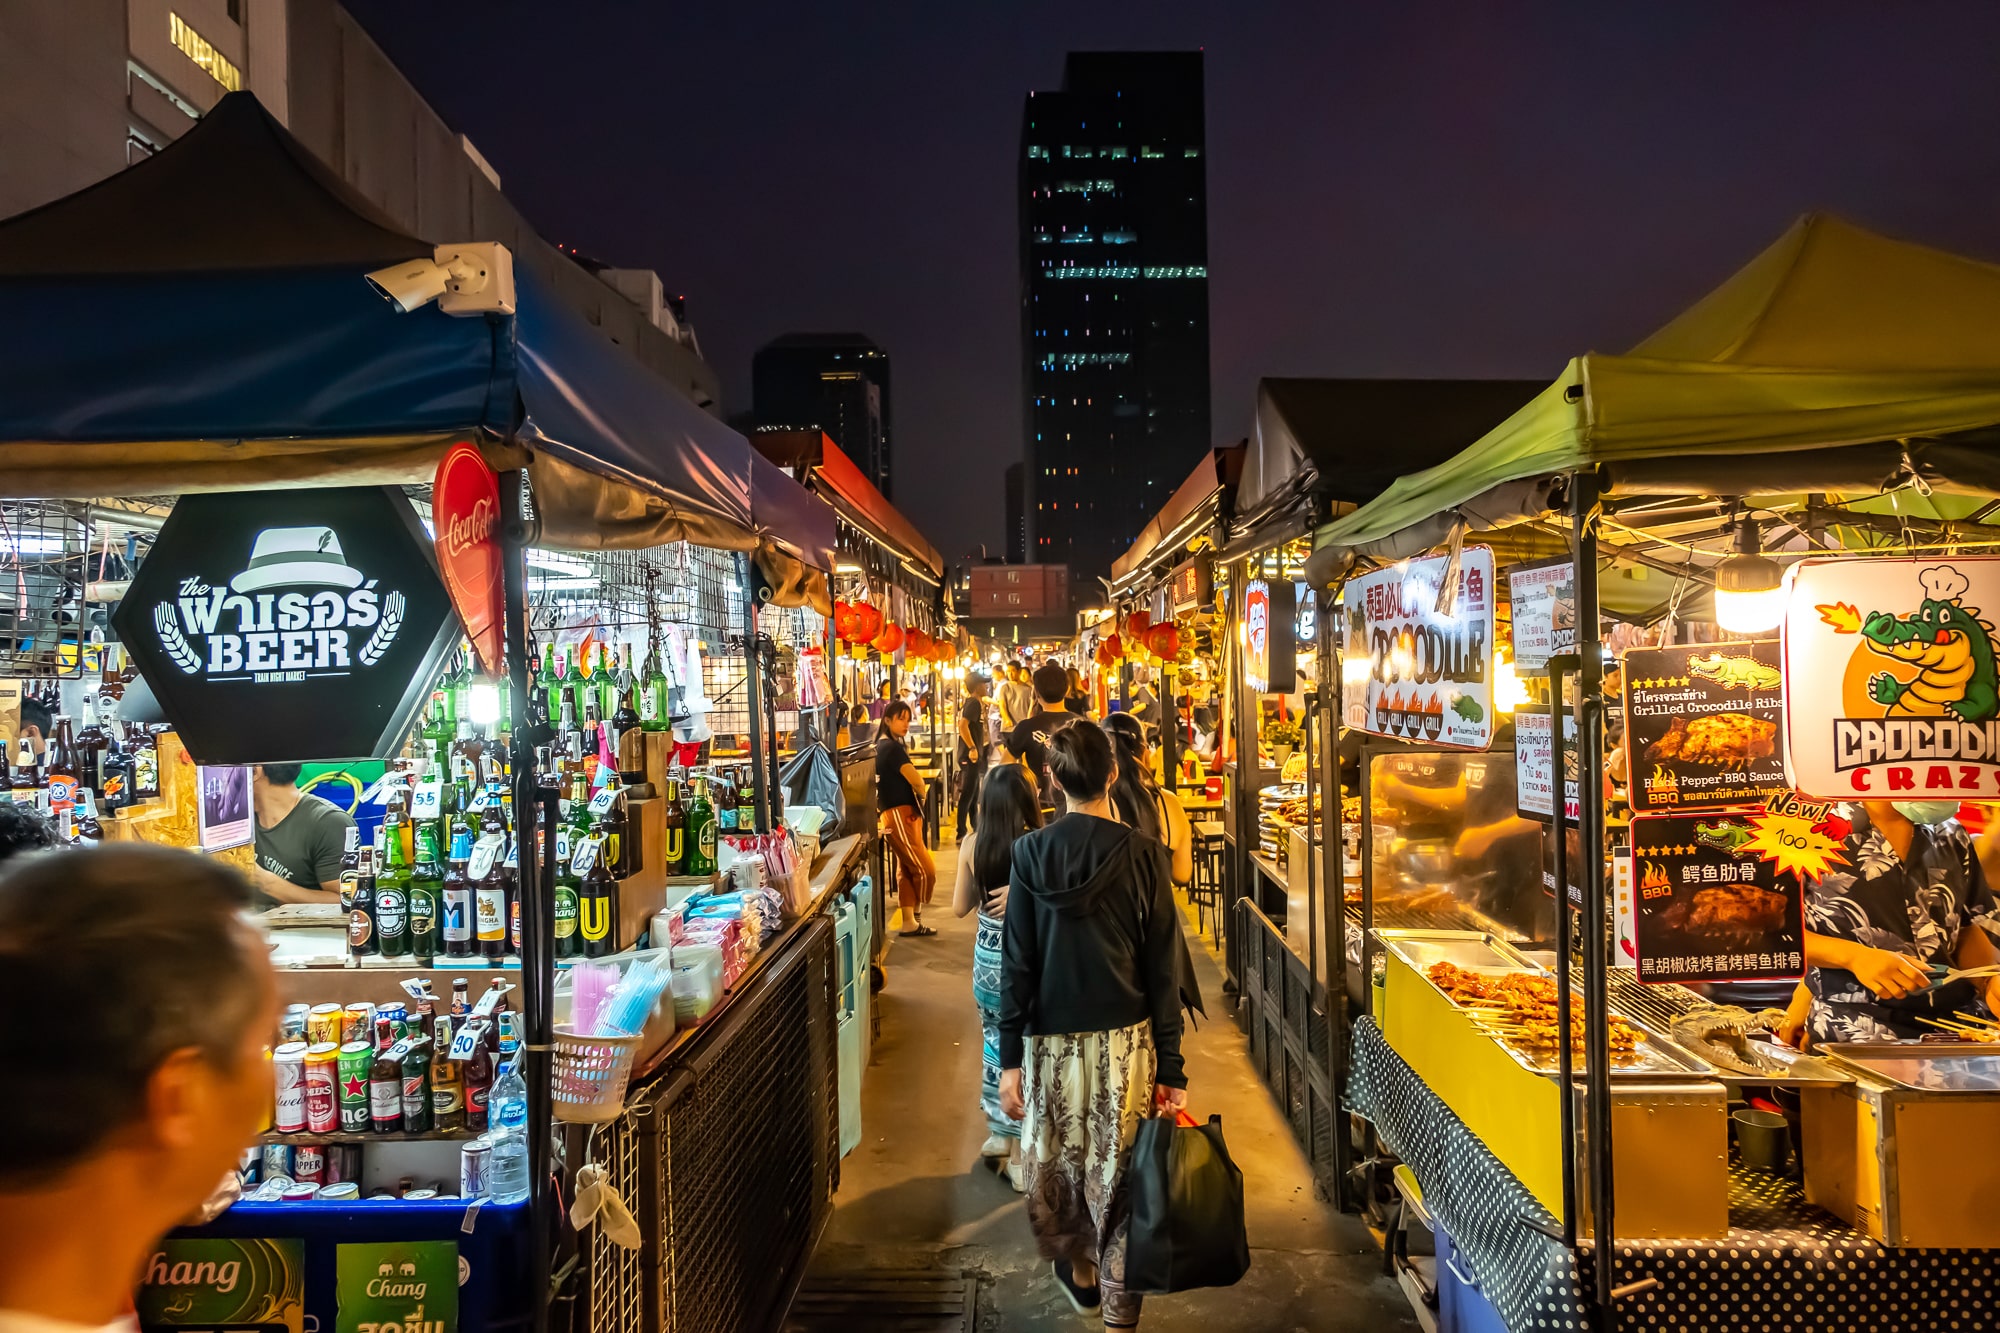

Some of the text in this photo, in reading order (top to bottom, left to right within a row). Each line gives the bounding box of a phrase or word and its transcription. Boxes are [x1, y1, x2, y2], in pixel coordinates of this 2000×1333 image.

[179, 575, 212, 597] the
[206, 629, 351, 673] BEER
[254, 670, 306, 683] TRAIN NIGHT MARKET
[1633, 697, 1783, 716] Grilled Crocodile Ribs
[1390, 712, 1403, 727] GRILL
[1406, 714, 1420, 729] GRILL
[1425, 716, 1440, 732] GRILL
[1837, 720, 2000, 769] CROCODI
[1525, 782, 1540, 791] STICK
[1681, 775, 1723, 789] Pepper
[1724, 773, 1747, 785] BBQ
[1749, 771, 1784, 782] Sauce
[415, 792, 435, 806] 55
[1648, 792, 1679, 805] BBQ
[1766, 791, 1833, 822] New!
[572, 842, 599, 871] 65
[1681, 862, 1757, 884] 鳄鱼肋骨
[1641, 885, 1673, 900] BBQ
[580, 896, 610, 941] U
[1641, 951, 1802, 975] 黑胡椒烧烤酱烤鳄鱼排骨
[453, 1035, 474, 1054] 90
[295, 1159, 320, 1171] APPER
[145, 1252, 241, 1293] hang
[366, 1279, 427, 1300] Chang
